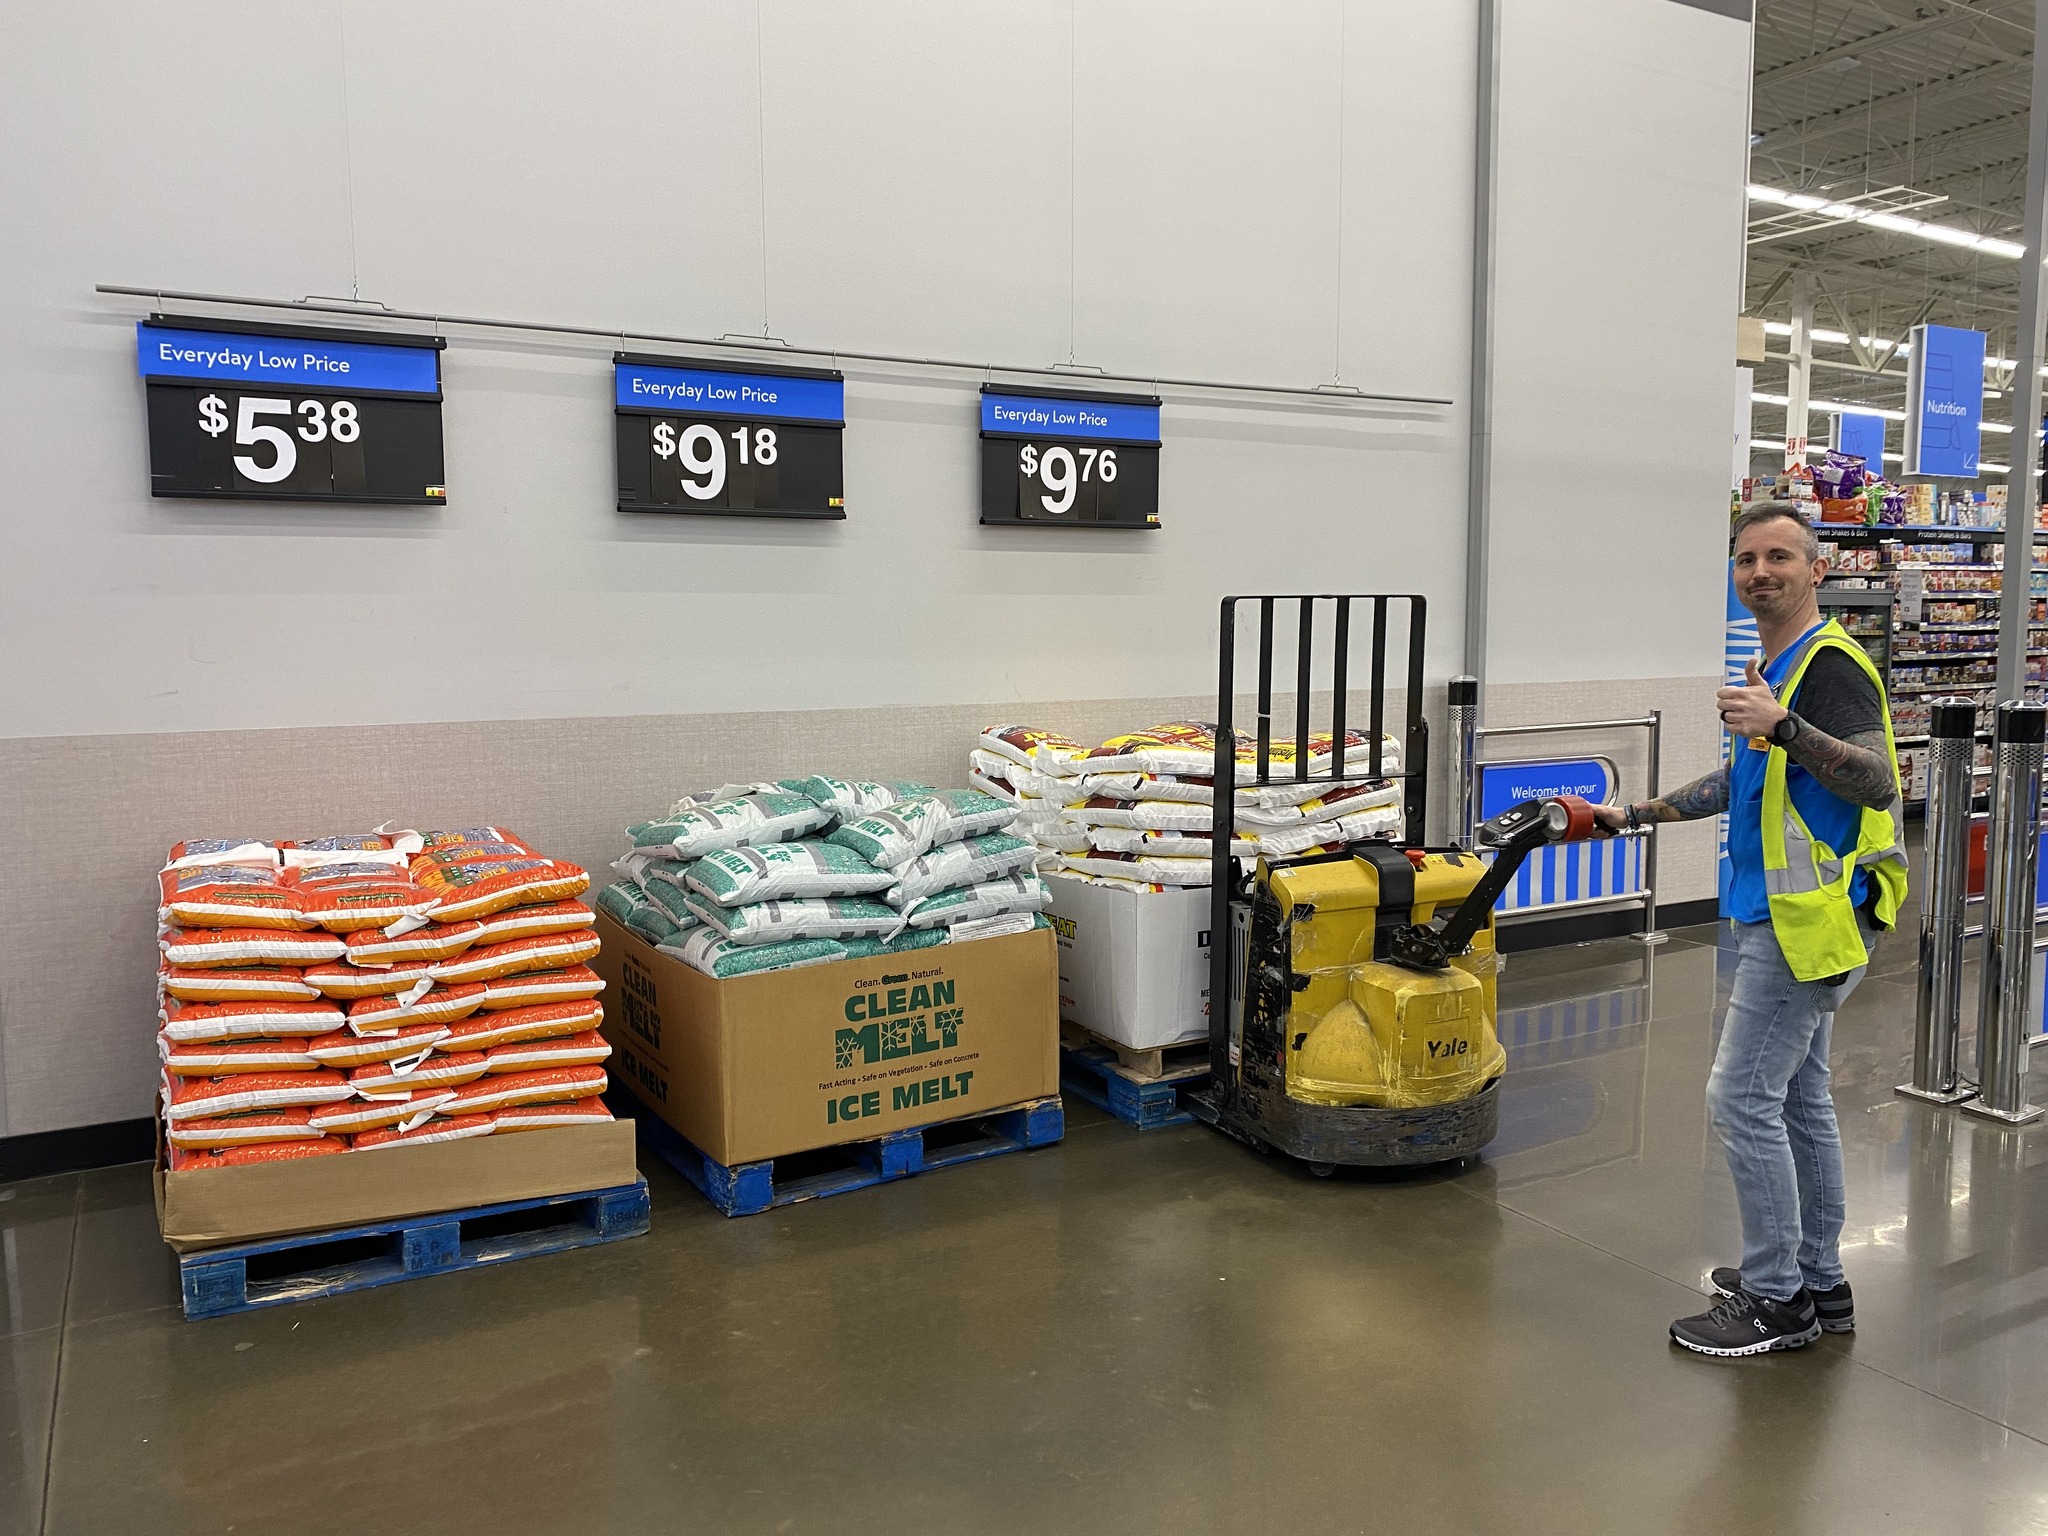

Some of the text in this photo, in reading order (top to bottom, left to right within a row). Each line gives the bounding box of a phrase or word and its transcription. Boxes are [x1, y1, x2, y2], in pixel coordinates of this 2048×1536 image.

[158, 342, 351, 374] Everyday Low Price
[631, 377, 779, 405] Everyday Low Price
[993, 405, 1109, 428] Everyday Low Price
[1926, 399, 1968, 417] Nutrition
[1917, 530, 1938, 538] Protein
[1511, 783, 1597, 799] Welcome to your
[857, 819, 896, 838] MELT
[720, 852, 754, 876] MELT
[622, 961, 658, 1008] CLEAN
[854, 977, 881, 990] Clean.
[911, 966, 944, 980] Natural.
[844, 979, 956, 1023] CLEAN
[835, 1006, 965, 1070] MELT
[1427, 1037, 1468, 1059] Yale
[621, 1045, 637, 1078] ICE
[638, 1059, 669, 1104] MELT
[818, 1052, 980, 1091] Fast Acting Safe on Vegetation Safe on Concrete
[827, 1070, 975, 1125] ICE MELT
